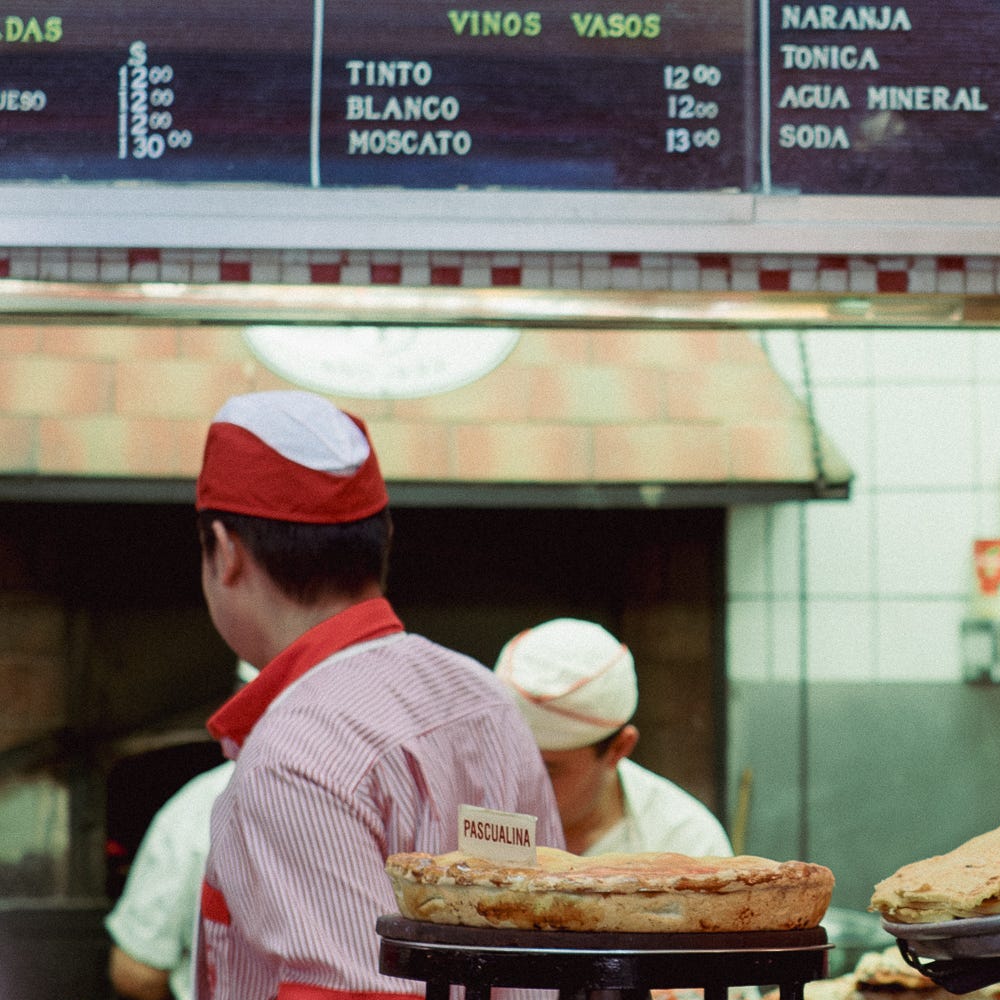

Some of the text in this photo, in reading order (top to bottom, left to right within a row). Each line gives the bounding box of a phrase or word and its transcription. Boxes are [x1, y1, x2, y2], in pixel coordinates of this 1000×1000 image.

[0, 17, 63, 43] DAS
[449, 11, 661, 38] VINOS VASOS
[784, 6, 912, 31] NARANJA
[782, 46, 880, 70] TONICA
[347, 62, 433, 87] TINTO
[348, 96, 460, 121] BLANCO
[780, 86, 851, 109] AGUA
[869, 87, 989, 111] MINERAL
[350, 131, 472, 156] MOSCATO
[781, 126, 850, 149] SODA
[464, 819, 531, 847] PASCUALINA
